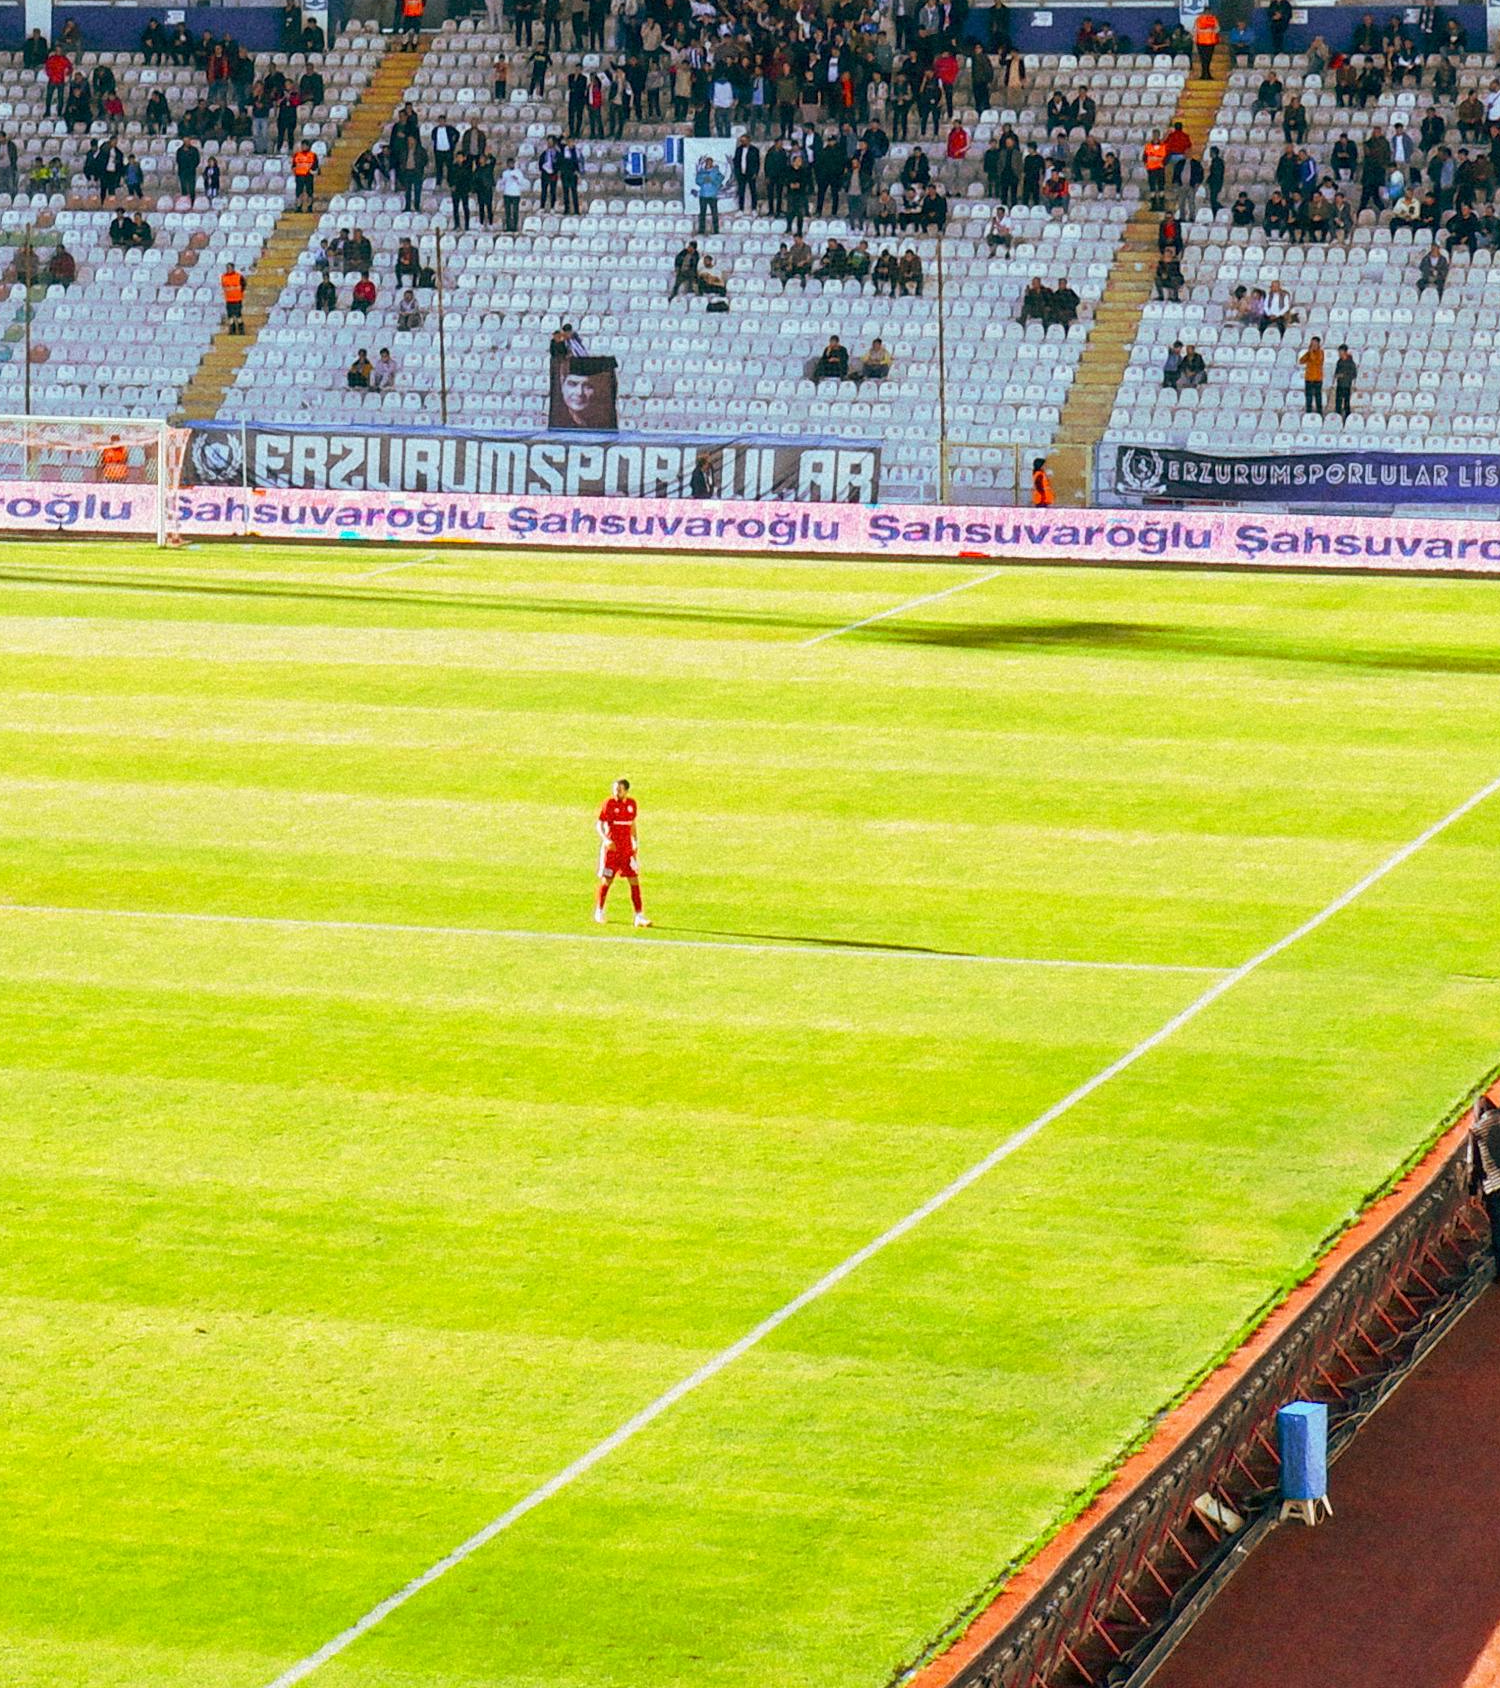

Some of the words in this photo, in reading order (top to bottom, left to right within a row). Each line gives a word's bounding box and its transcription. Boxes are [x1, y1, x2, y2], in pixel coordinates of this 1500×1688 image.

[1168, 459, 1449, 487] ERZURUMSPORLULAR
[508, 506, 840, 546] Şahsuvaroğlu
[868, 514, 1213, 555] Şahsuvaroğlu
